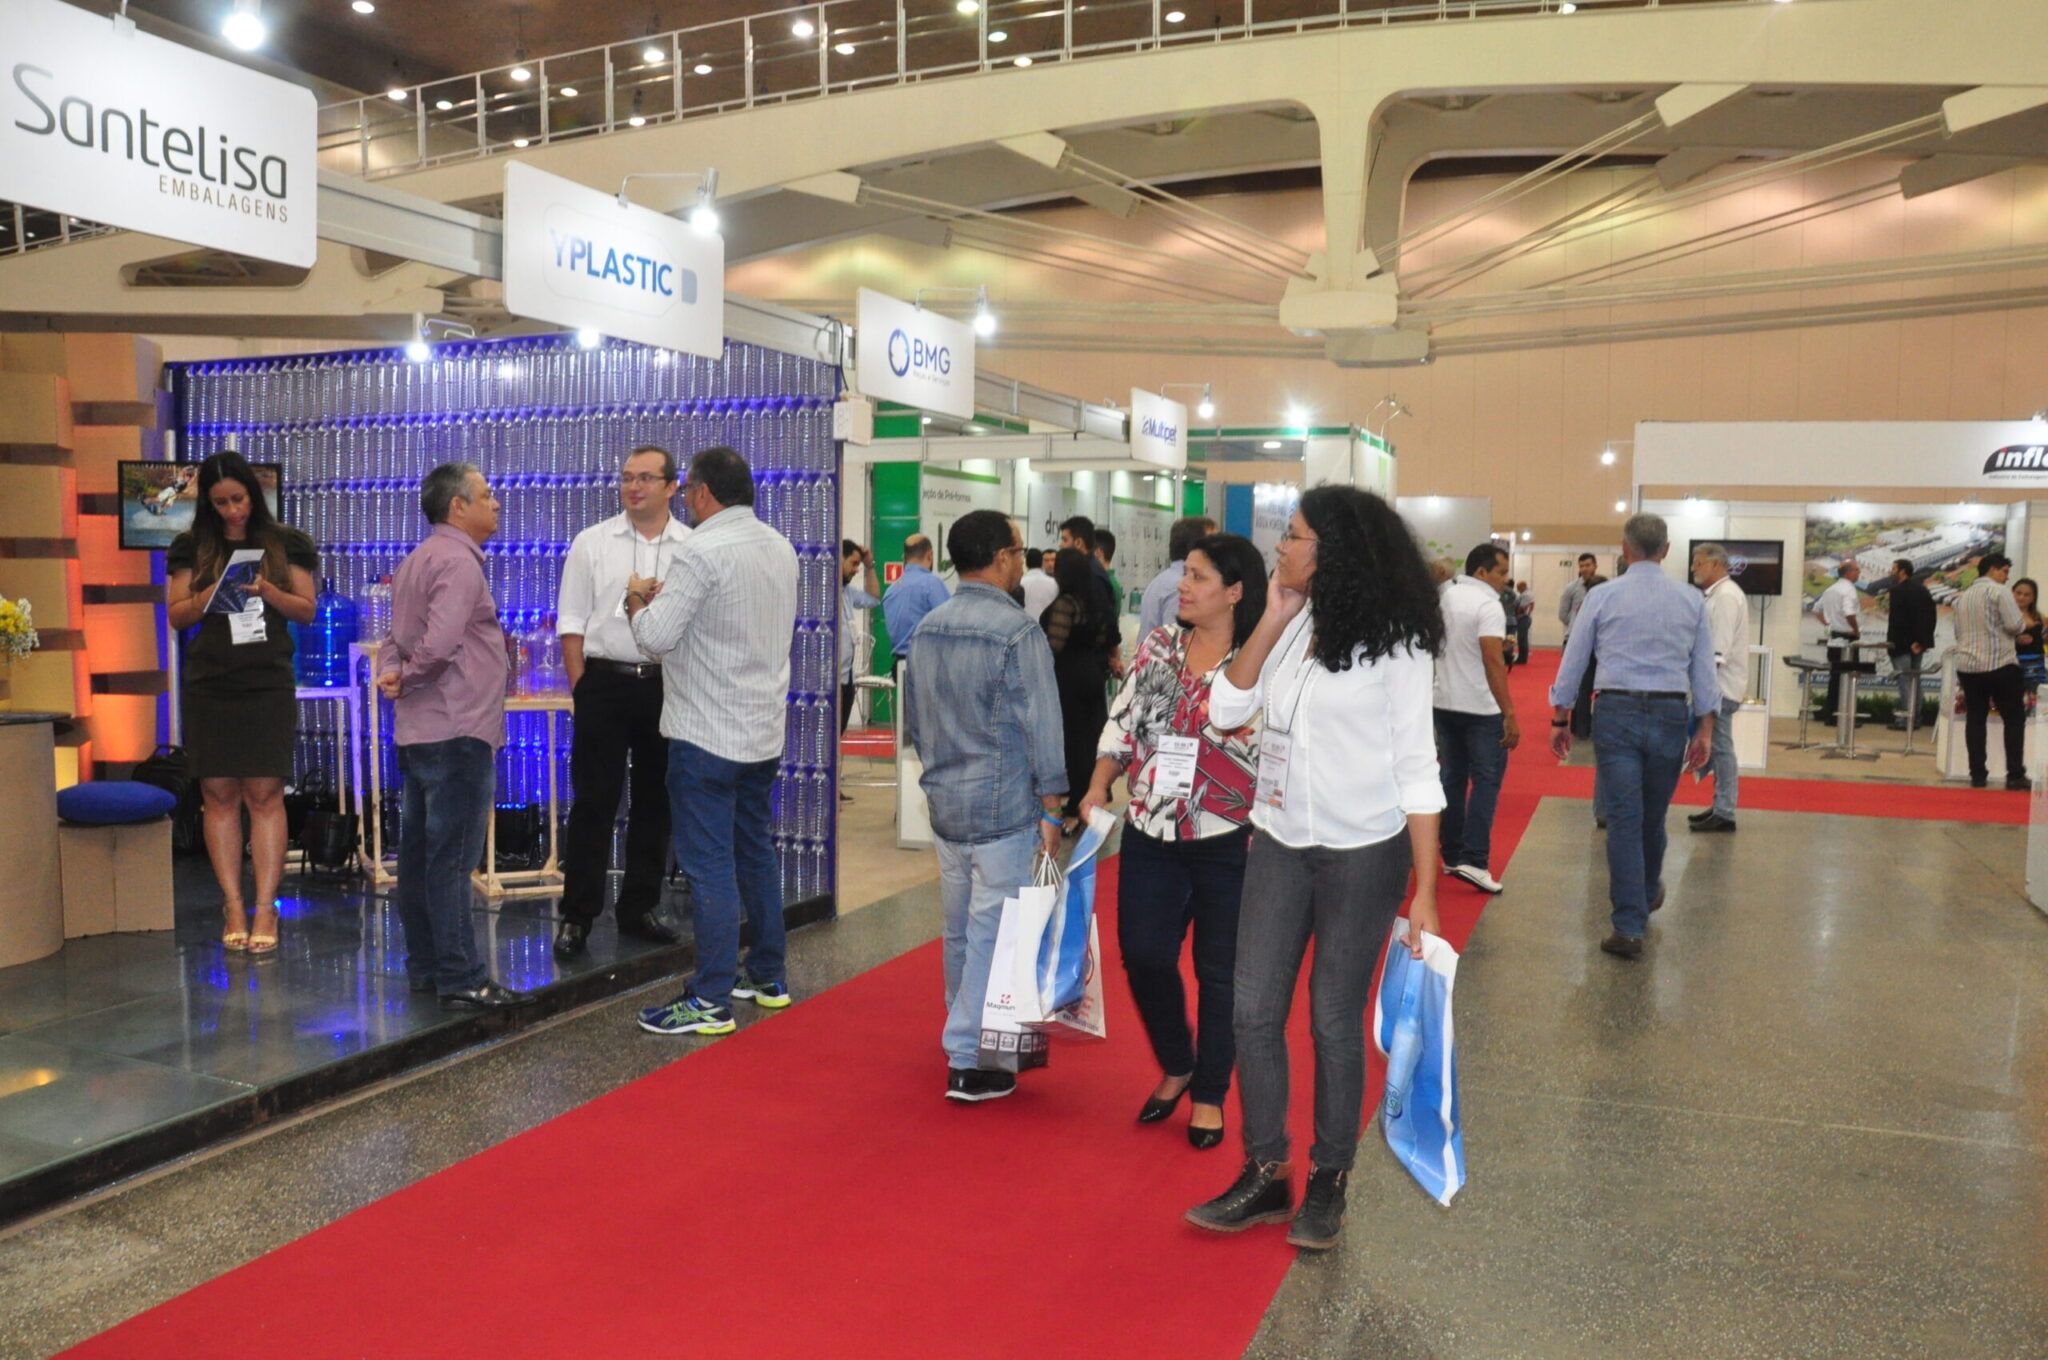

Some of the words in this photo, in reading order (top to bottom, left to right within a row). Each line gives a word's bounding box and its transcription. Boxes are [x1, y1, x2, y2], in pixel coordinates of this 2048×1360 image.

[12, 62, 287, 200] Santelisa
[158, 174, 289, 224] EMBALAGENS
[550, 226, 674, 297] YPLASTIC
[912, 337, 951, 375] BMG
